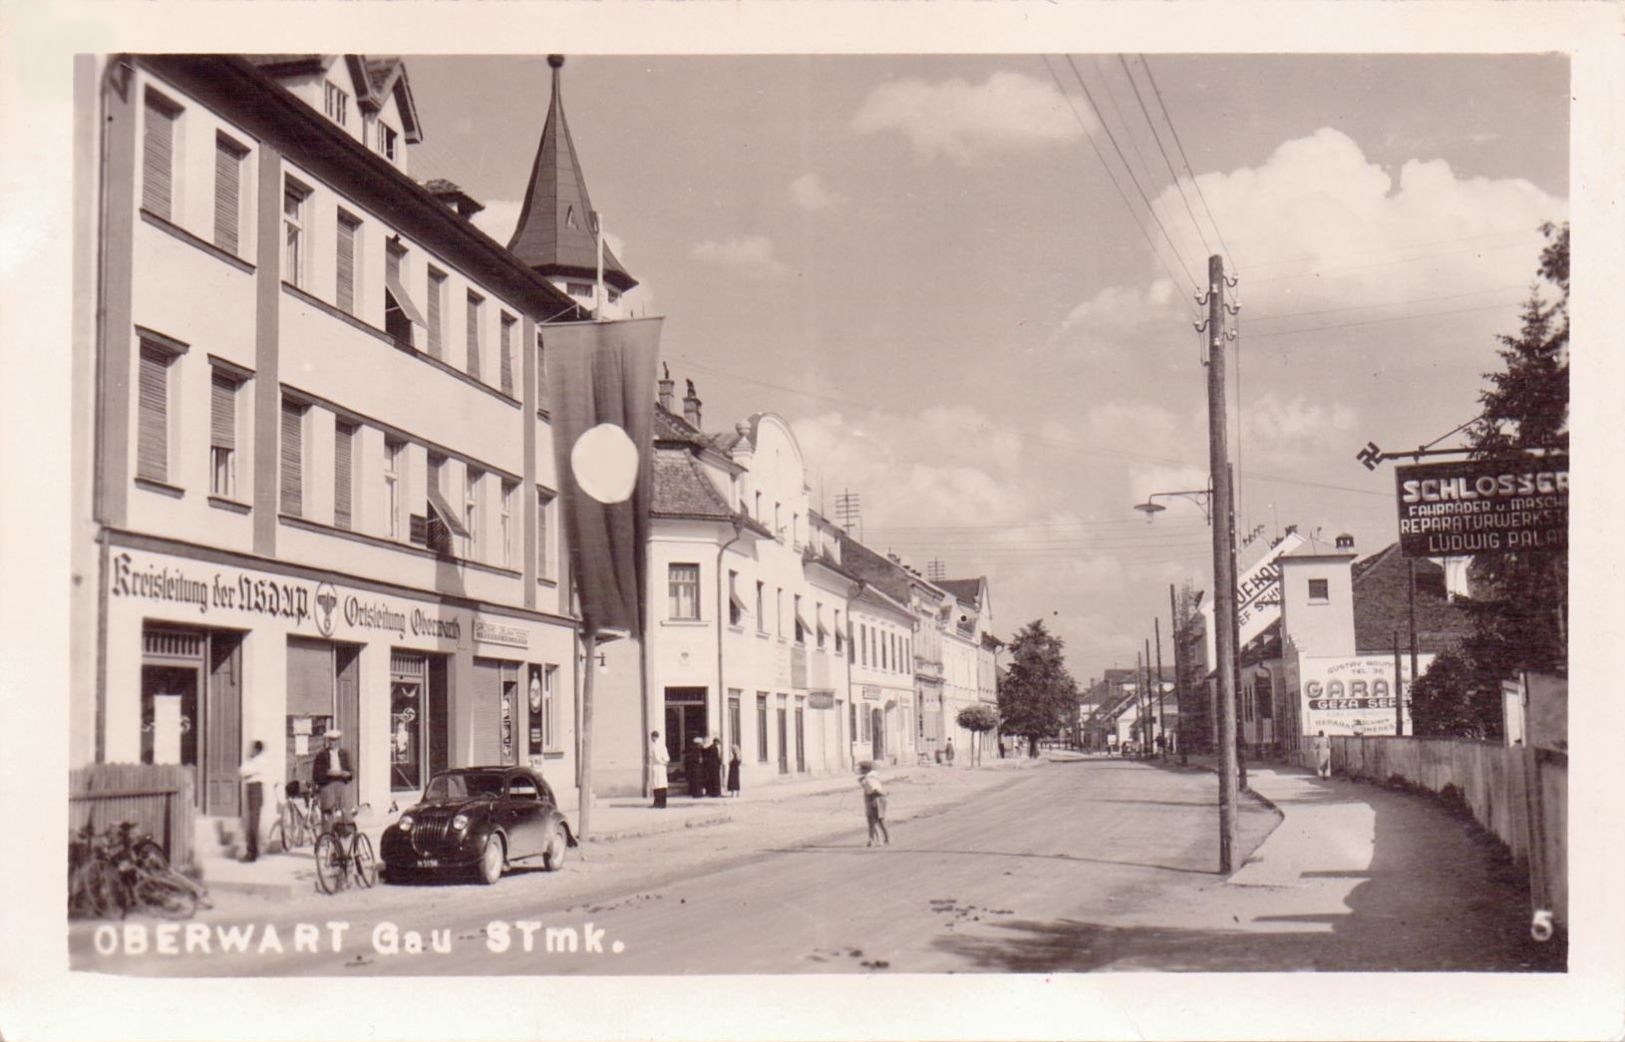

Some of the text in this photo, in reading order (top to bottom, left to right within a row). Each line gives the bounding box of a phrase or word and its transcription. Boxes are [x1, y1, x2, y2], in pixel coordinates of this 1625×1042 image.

[1400, 509, 1568, 535] REPARATURWERKST
[1429, 532, 1500, 552] LUDWIG
[112, 552, 208, 614] Kreisleitung
[212, 573, 236, 609] der
[343, 594, 406, 640] Ortsleitung
[1303, 677, 1410, 699] GARA
[1318, 699, 1359, 711] GEZA
